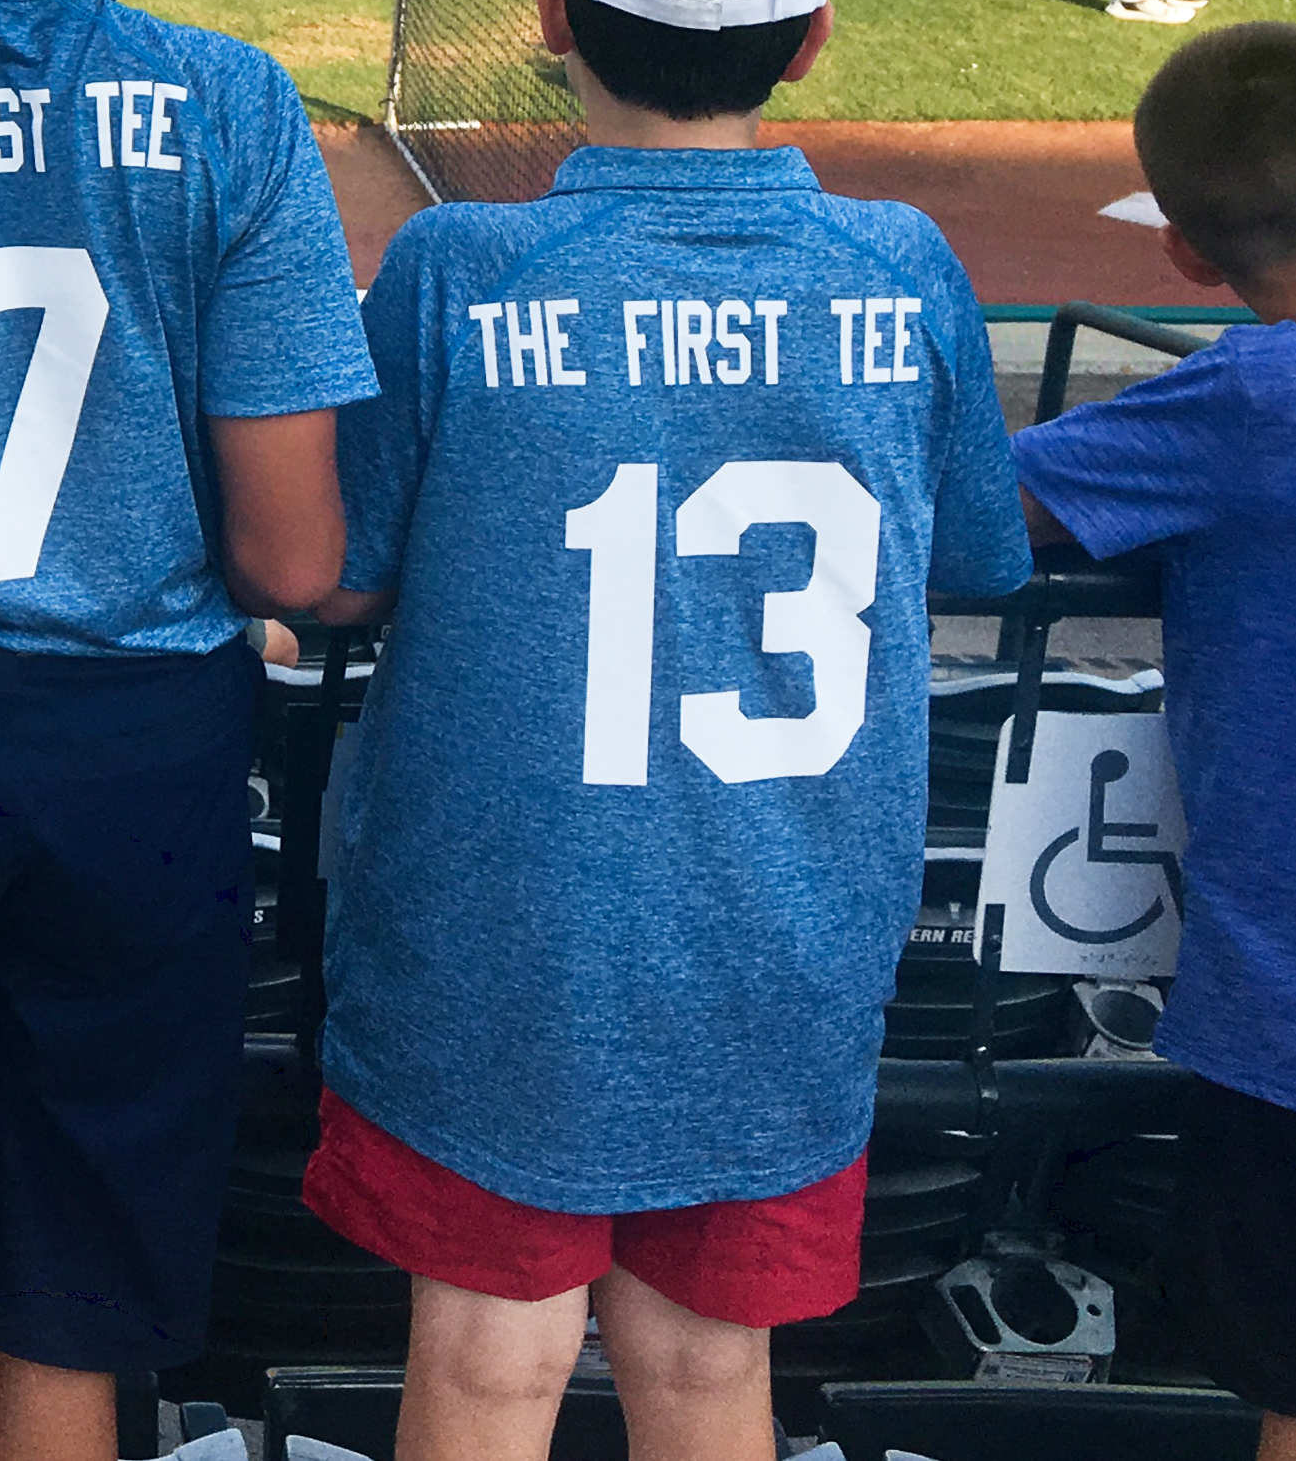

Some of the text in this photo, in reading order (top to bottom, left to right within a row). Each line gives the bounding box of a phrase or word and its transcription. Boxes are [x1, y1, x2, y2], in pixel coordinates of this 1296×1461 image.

[84, 79, 189, 173] TEE
[468, 296, 922, 388] THE FIRST TEE
[565, 459, 882, 787] 13
